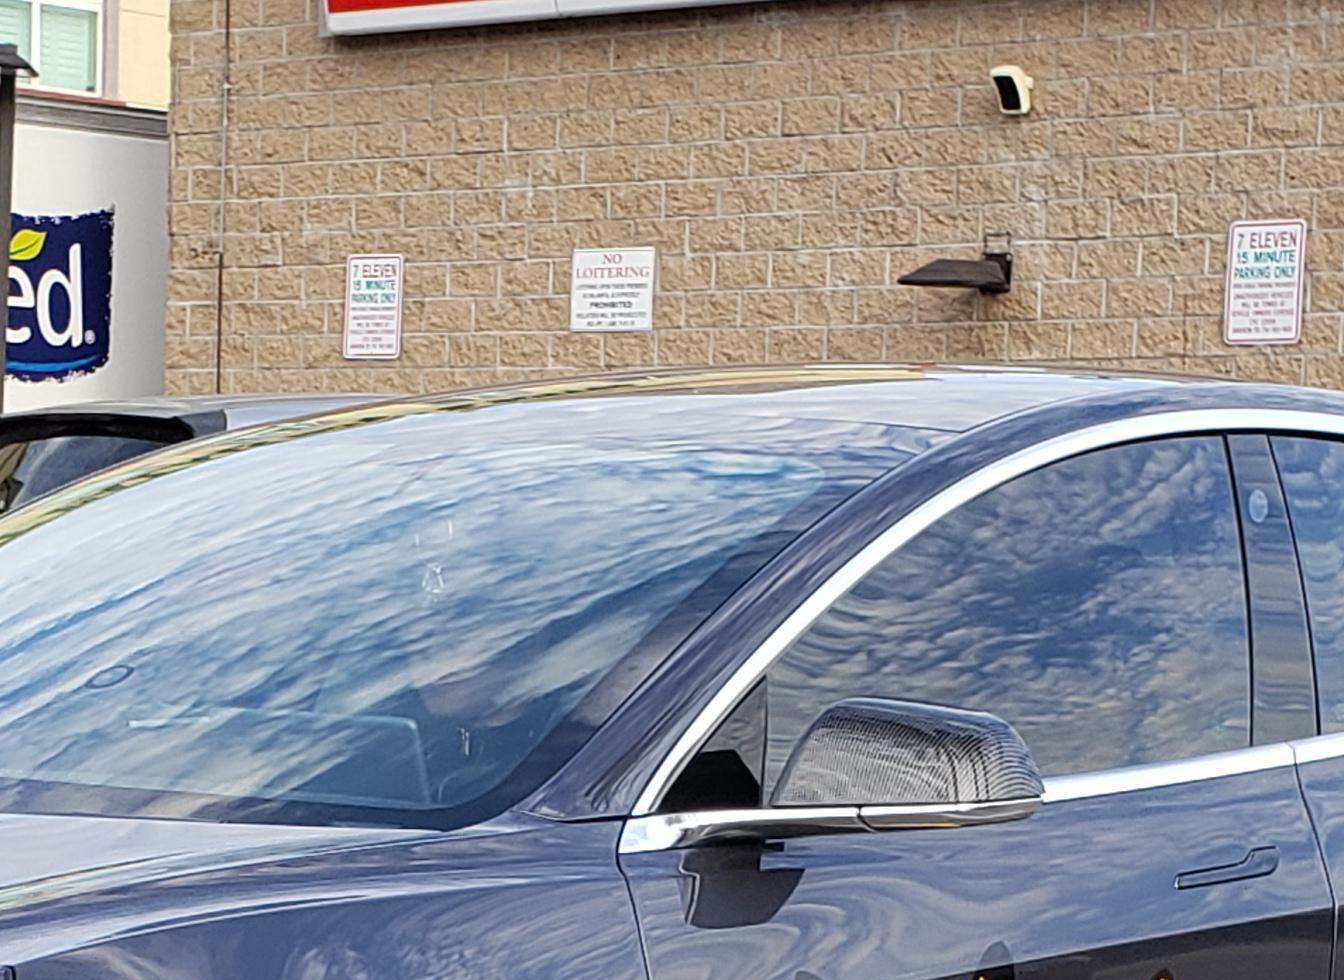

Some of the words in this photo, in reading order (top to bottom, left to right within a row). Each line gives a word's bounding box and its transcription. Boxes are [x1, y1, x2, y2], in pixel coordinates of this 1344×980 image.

[1238, 233, 1245, 249] 7
[1250, 231, 1297, 249] ELEVEN
[602, 253, 623, 265] NO
[1237, 251, 1249, 264] 15
[1254, 249, 1296, 263] MINUTE
[362, 263, 397, 278] ELEVEN
[576, 266, 650, 279] LOITERING
[1234, 266, 1271, 279] PARKING
[1274, 265, 1296, 278] ONLY
[365, 280, 396, 291] MINUTE
